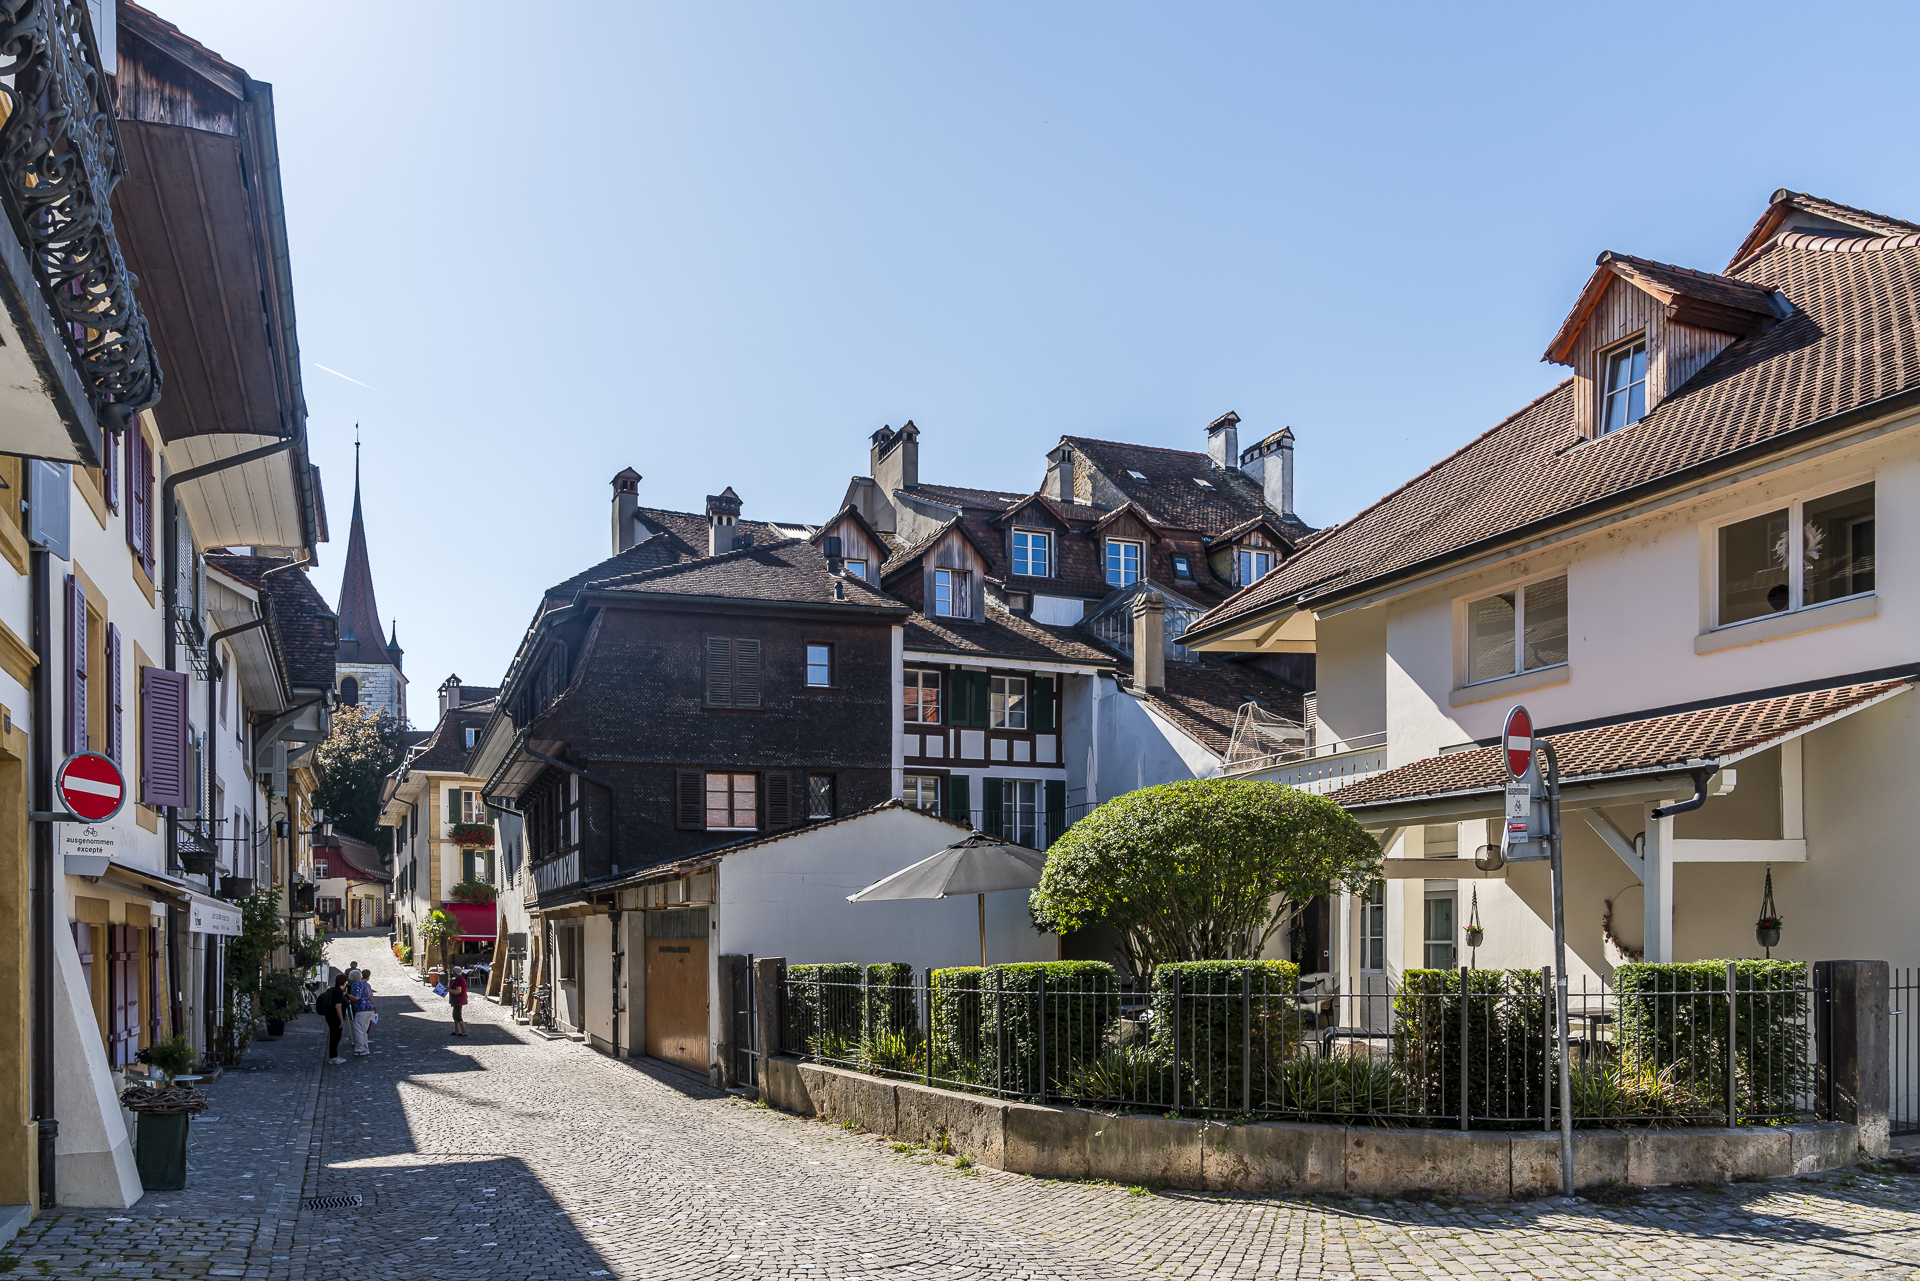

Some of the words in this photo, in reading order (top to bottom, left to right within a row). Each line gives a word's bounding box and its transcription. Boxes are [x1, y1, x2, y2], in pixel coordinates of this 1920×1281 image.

[66, 837, 114, 846] ausgenommen
[77, 846, 103, 854] excepté
[1444, 913, 1449, 922] 3
